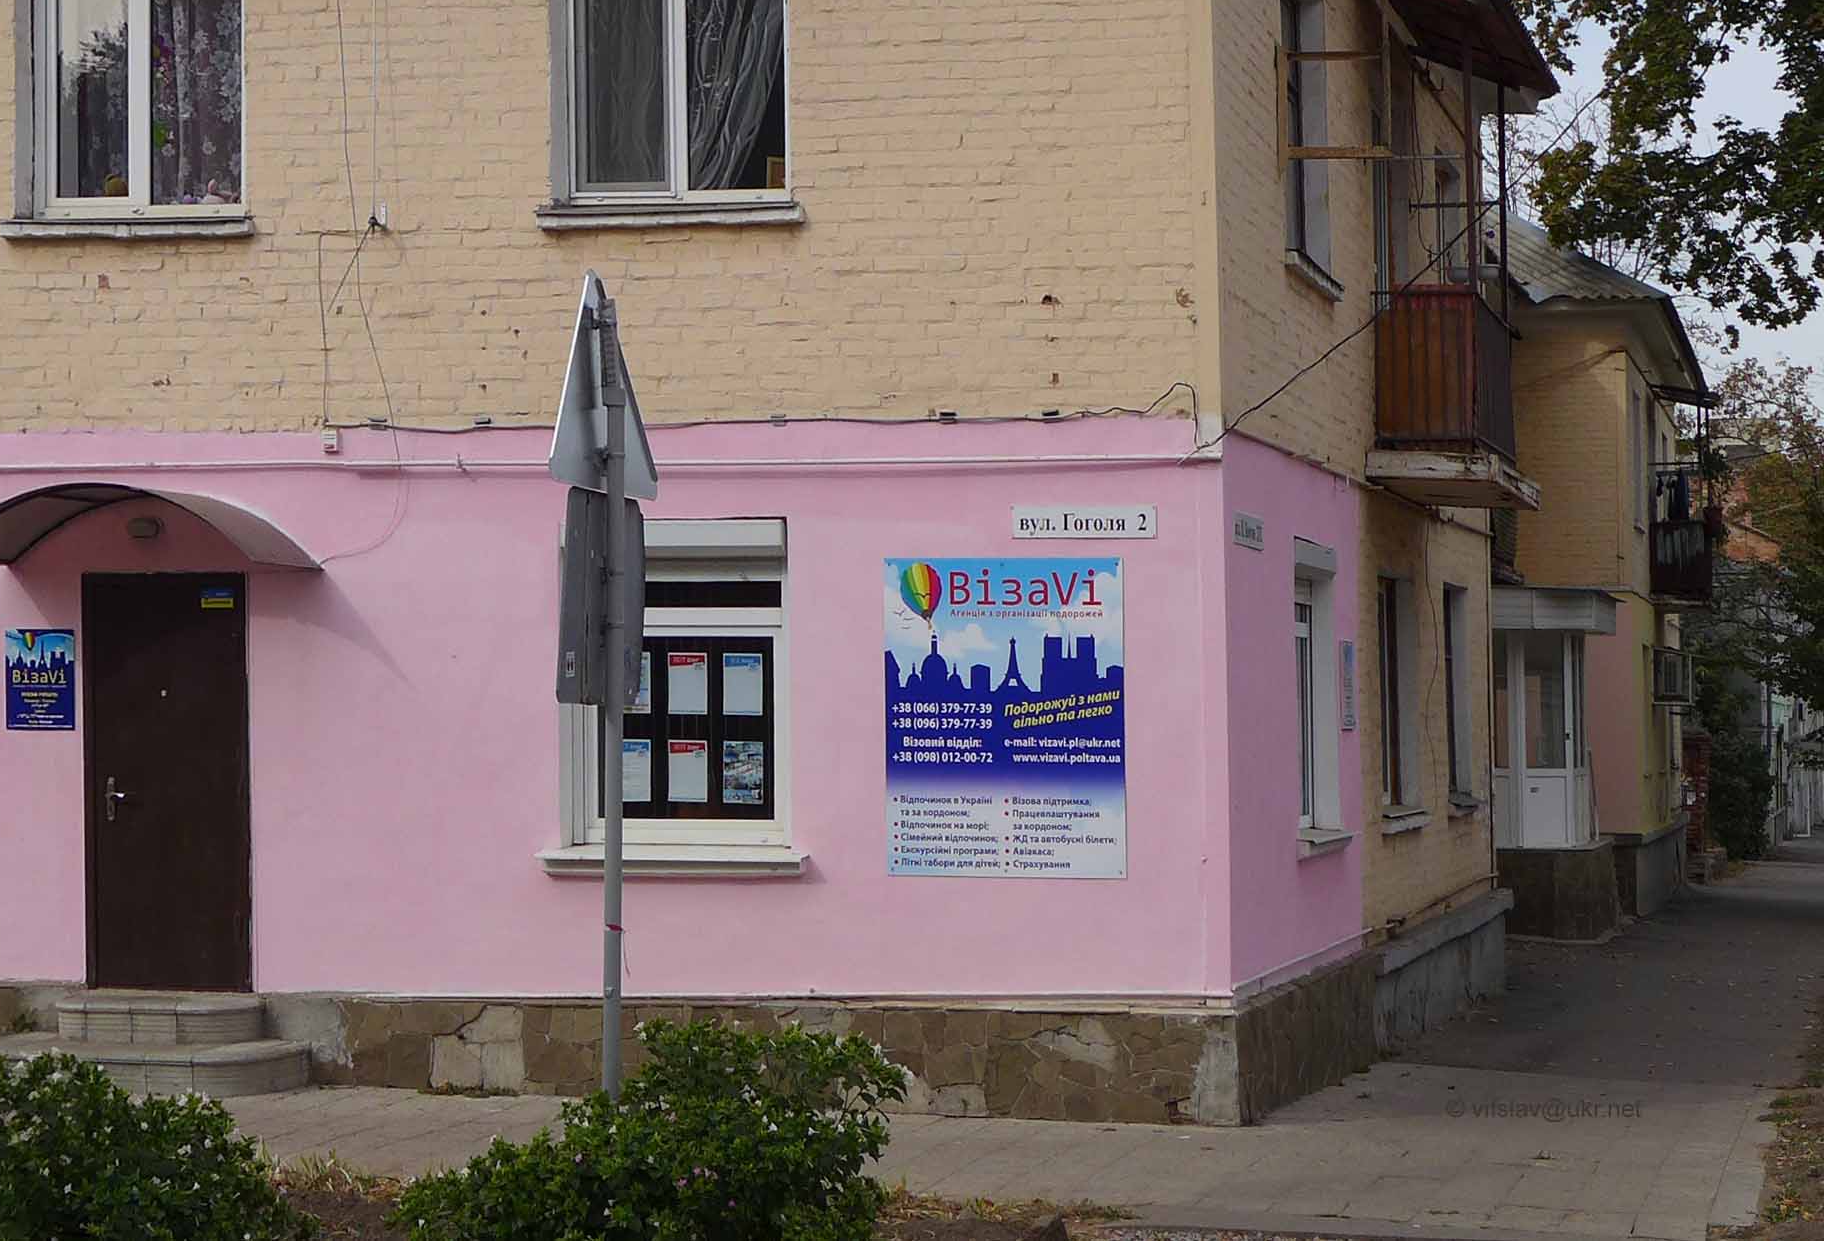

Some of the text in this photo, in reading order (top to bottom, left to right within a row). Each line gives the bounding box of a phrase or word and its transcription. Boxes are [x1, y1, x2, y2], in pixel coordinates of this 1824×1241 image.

[1020, 513, 1147, 536] вул. Гоголя 2
[950, 609, 985, 619] Агенція
[996, 609, 1047, 619] організації
[1050, 609, 1103, 619] подорожей
[892, 702, 992, 715] +38 (066) 379-77-39
[1004, 690, 1120, 716] Подорожуй з нами
[1013, 704, 1112, 729] вільно та легко
[892, 718, 992, 730] +38 (096) 379-77-39
[903, 736, 982, 749] Візовий відділ:
[1004, 737, 1121, 750] e-mail: vizavi.pl@ukr.net
[892, 752, 993, 764] +38 (098) 012-00-72
[1013, 752, 1121, 765] www.vizavi.poltava.ua
[900, 795, 952, 806] Відпочинок
[960, 796, 992, 806] Україні
[1012, 797, 1041, 805] Візова
[1012, 809, 1100, 820] Працевлаштування
[900, 820, 952, 830] Відпочинок
[900, 832, 943, 841] Сімейний
[1012, 835, 1028, 844] ЖД
[1041, 834, 1083, 845] автобусні
[901, 845, 951, 856] Екскурсійні
[924, 859, 955, 868] табори
[1012, 859, 1071, 870] Страхування
